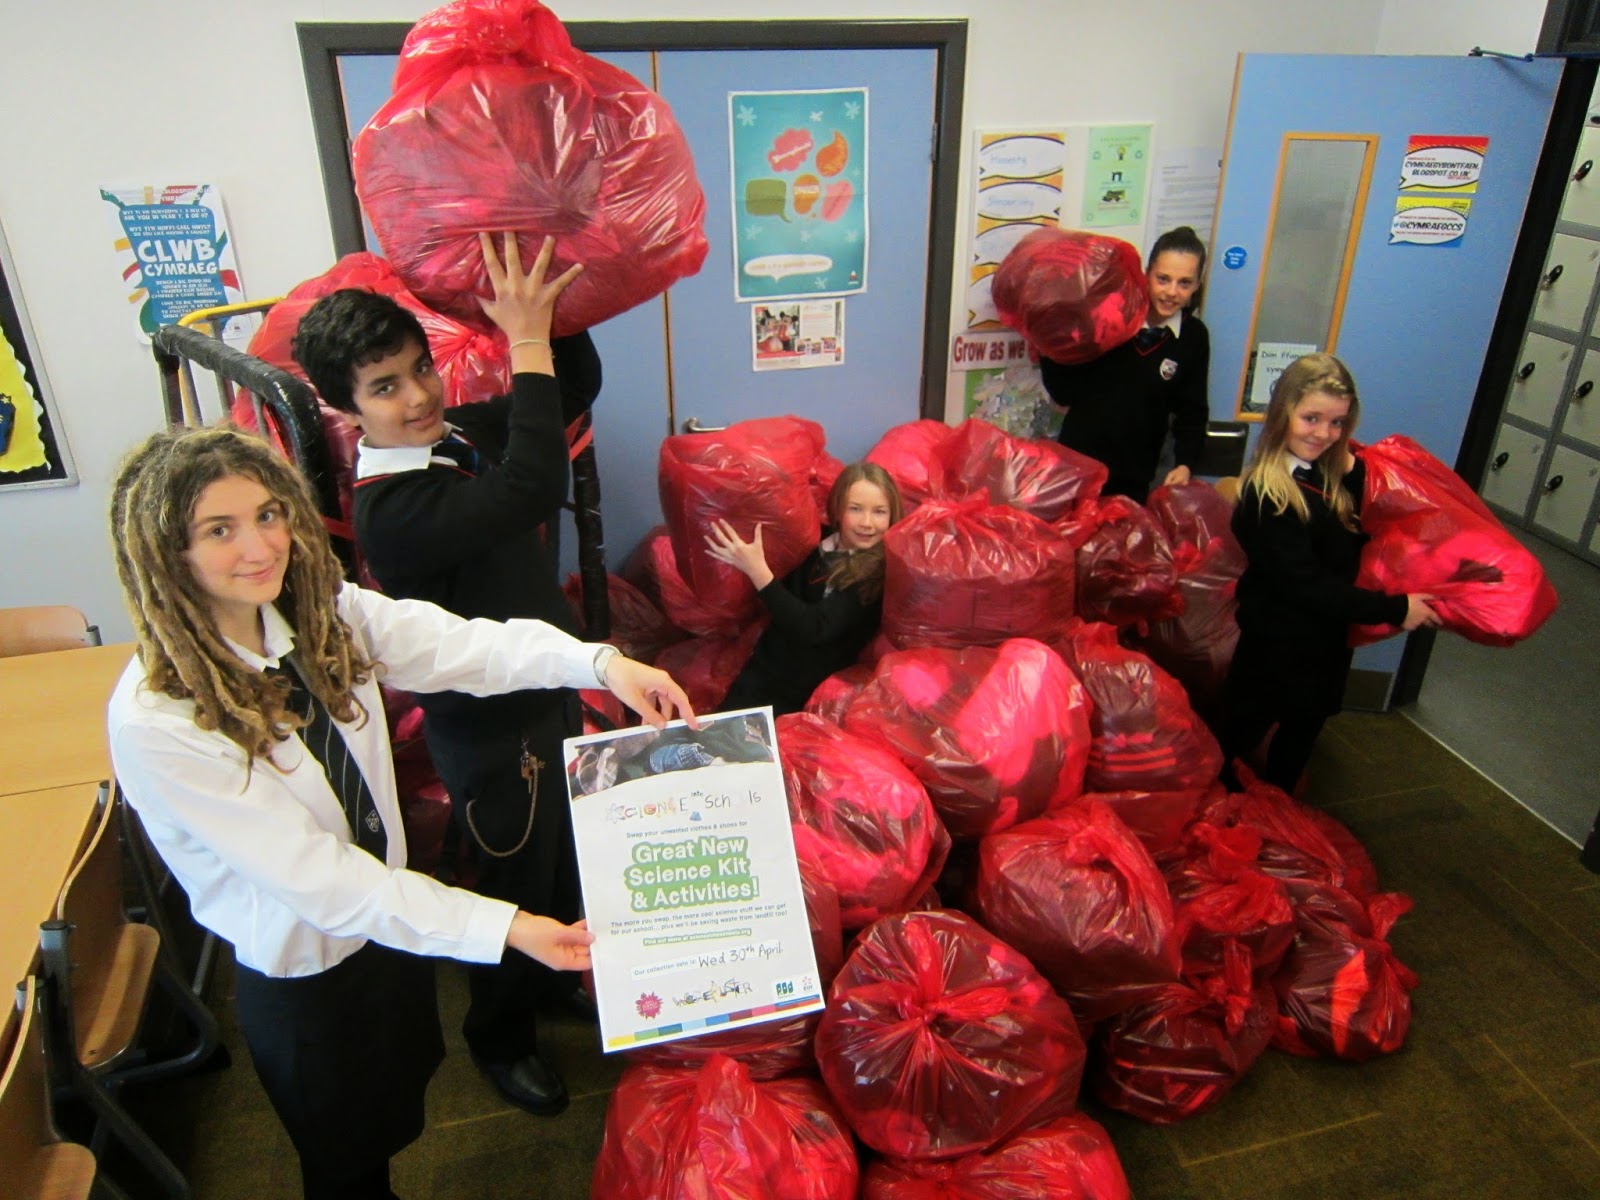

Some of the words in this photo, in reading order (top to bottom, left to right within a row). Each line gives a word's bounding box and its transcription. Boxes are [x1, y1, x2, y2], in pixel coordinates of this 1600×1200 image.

[138, 238, 215, 262] CLWB
[144, 262, 217, 276] CYMRAEG
[954, 336, 986, 362] Grow
[989, 341, 1004, 360] as
[1008, 340, 1025, 359] we
[705, 790, 762, 809] Schls
[626, 831, 643, 839] Swap
[661, 827, 688, 835] unwanted
[690, 824, 712, 832] clothes
[636, 841, 695, 864] Great
[701, 837, 745, 856] New
[629, 864, 712, 886] Science
[718, 857, 747, 876] Kit
[634, 892, 648, 909] &
[654, 877, 758, 907] Activities!
[776, 903, 786, 911] get
[661, 922, 674, 930] plus
[700, 918, 719, 926] saving
[698, 953, 725, 968] Wed
[729, 944, 755, 962] 30th
[647, 963, 674, 973] collection
